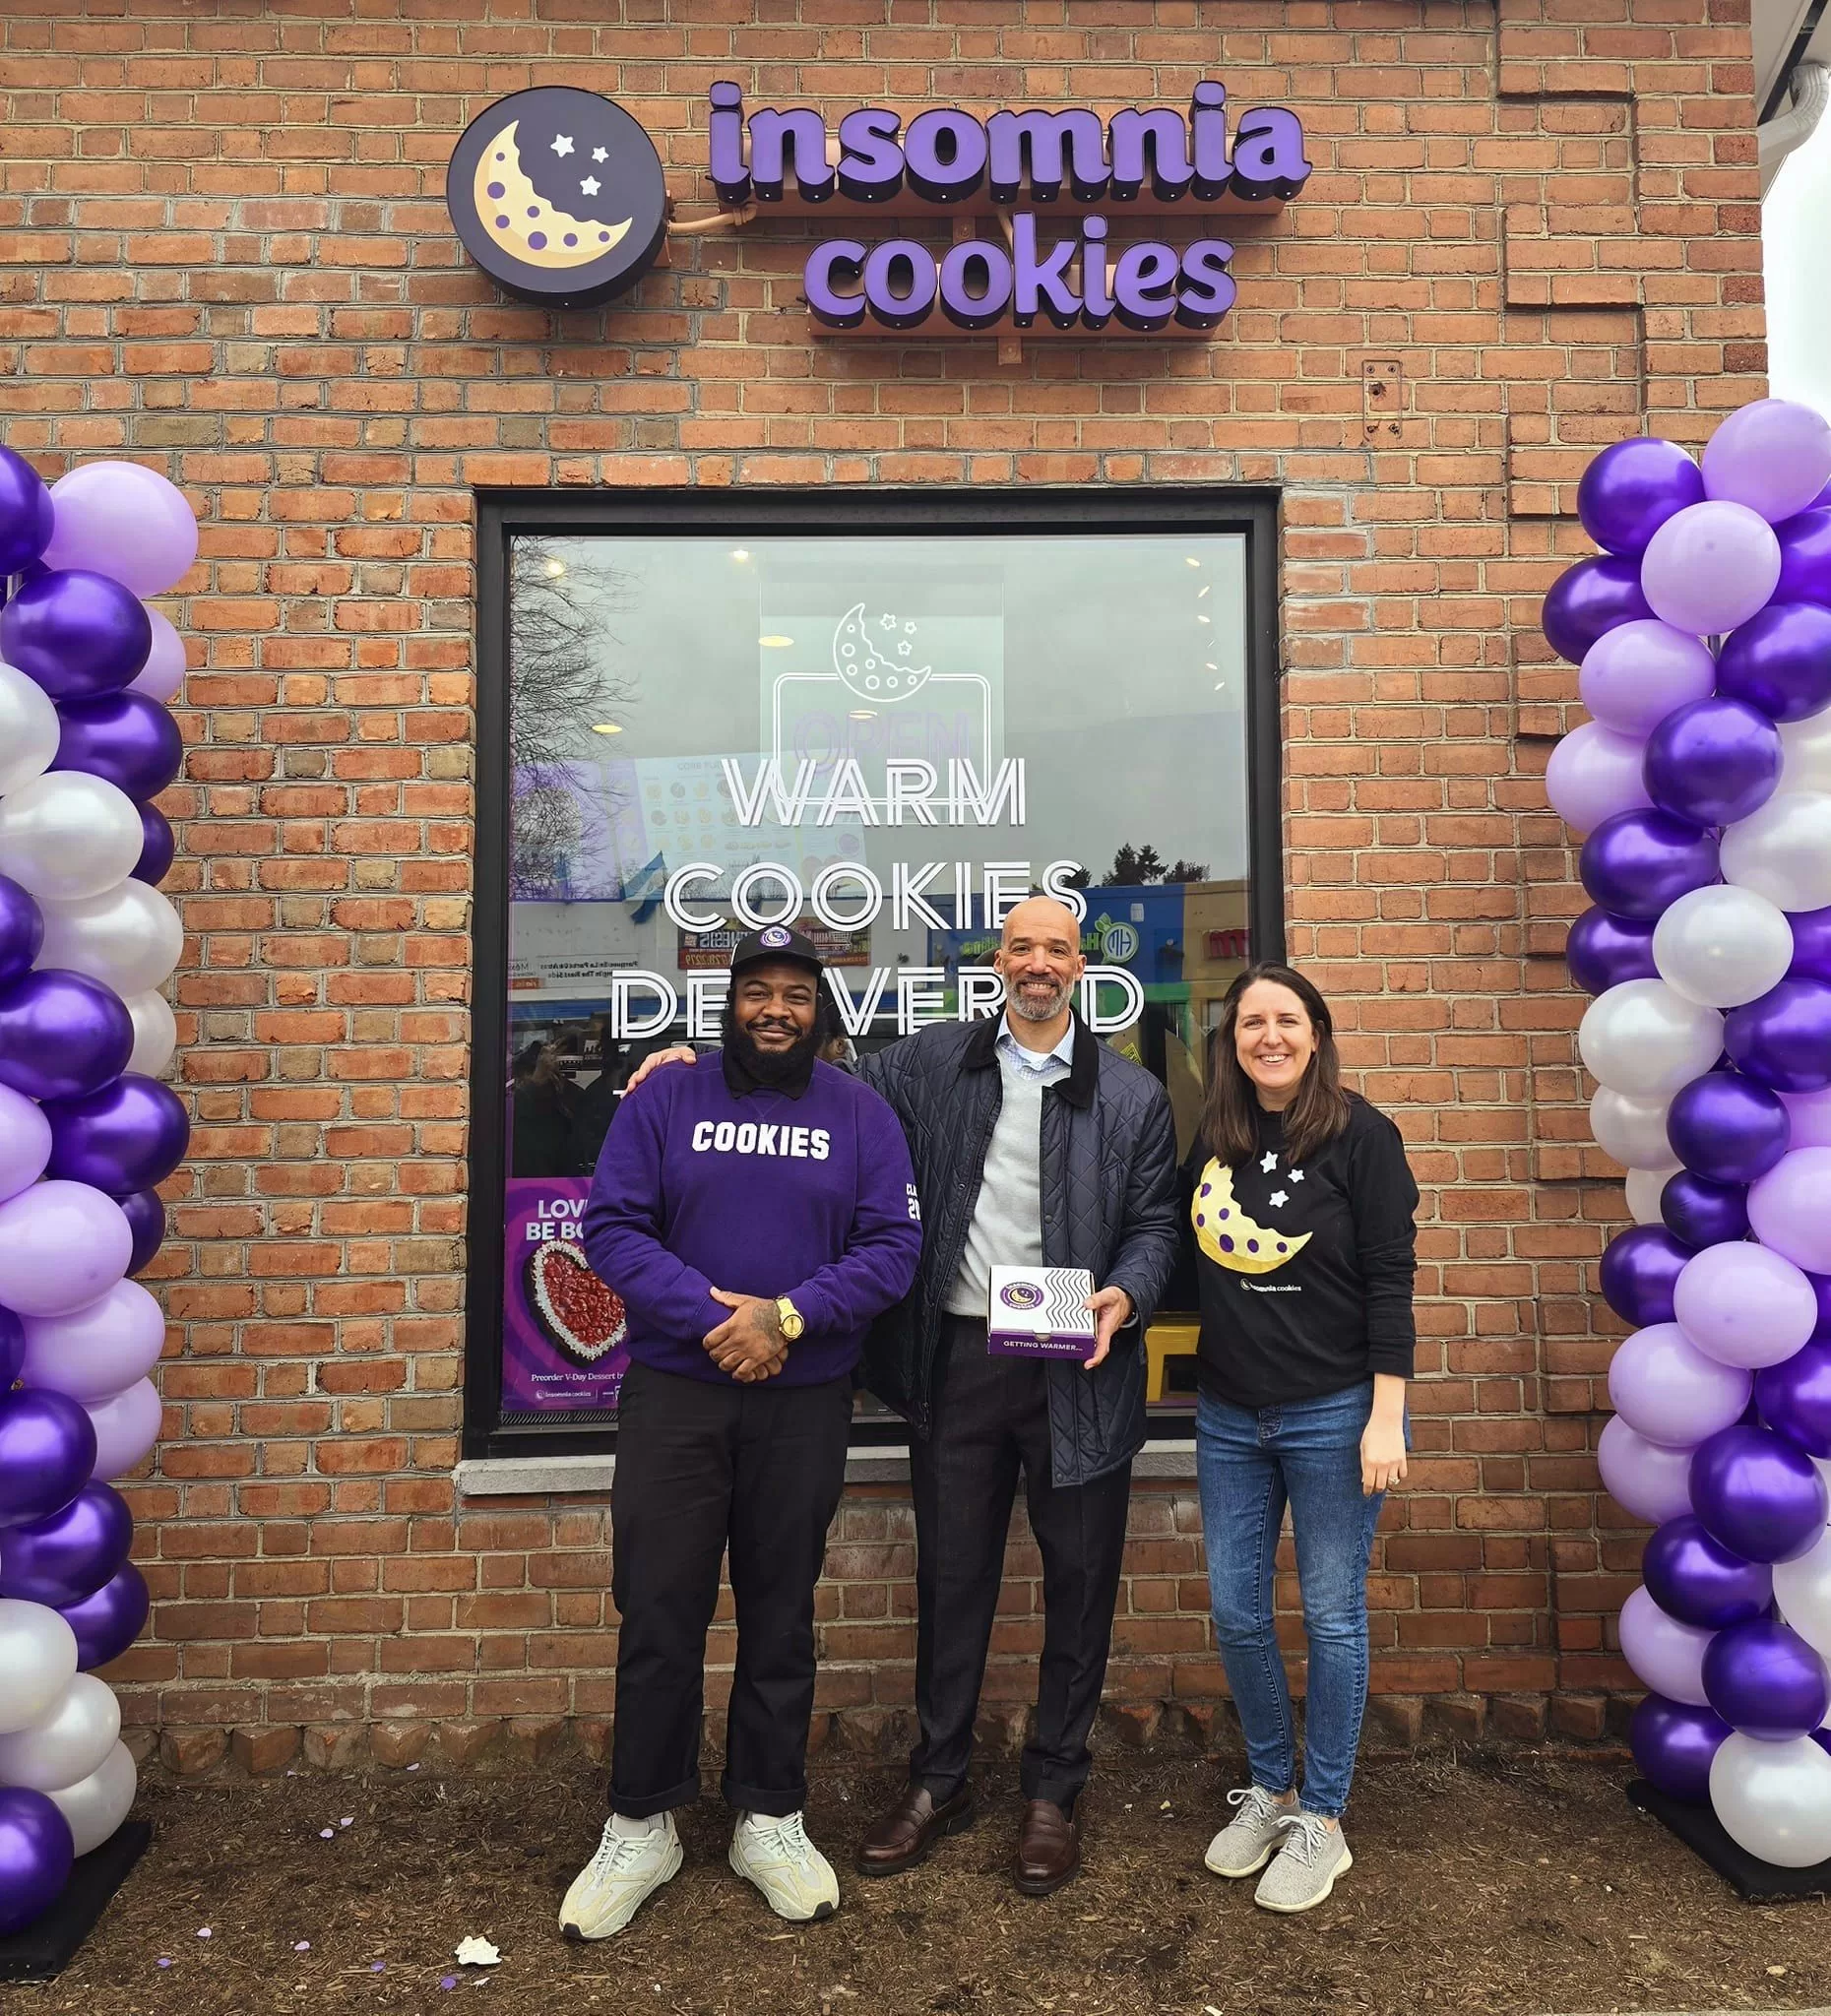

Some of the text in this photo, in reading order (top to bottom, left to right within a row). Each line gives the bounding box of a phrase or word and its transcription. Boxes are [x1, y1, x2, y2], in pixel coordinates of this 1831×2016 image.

[709, 81, 1313, 201] insomnia
[803, 212, 1238, 328] cookies
[793, 709, 971, 774] OPEN
[722, 757, 1026, 827] WARM
[663, 859, 1089, 933] COOKIES
[609, 964, 1146, 1040] DEVERD
[691, 1120, 831, 1161] COOKIES
[526, 1222, 555, 1240] BE
[537, 1199, 589, 1219] LOV
[531, 1373, 564, 1382] Preorder
[565, 1372, 588, 1383] V-Day
[1003, 1340, 1041, 1350] GETTING
